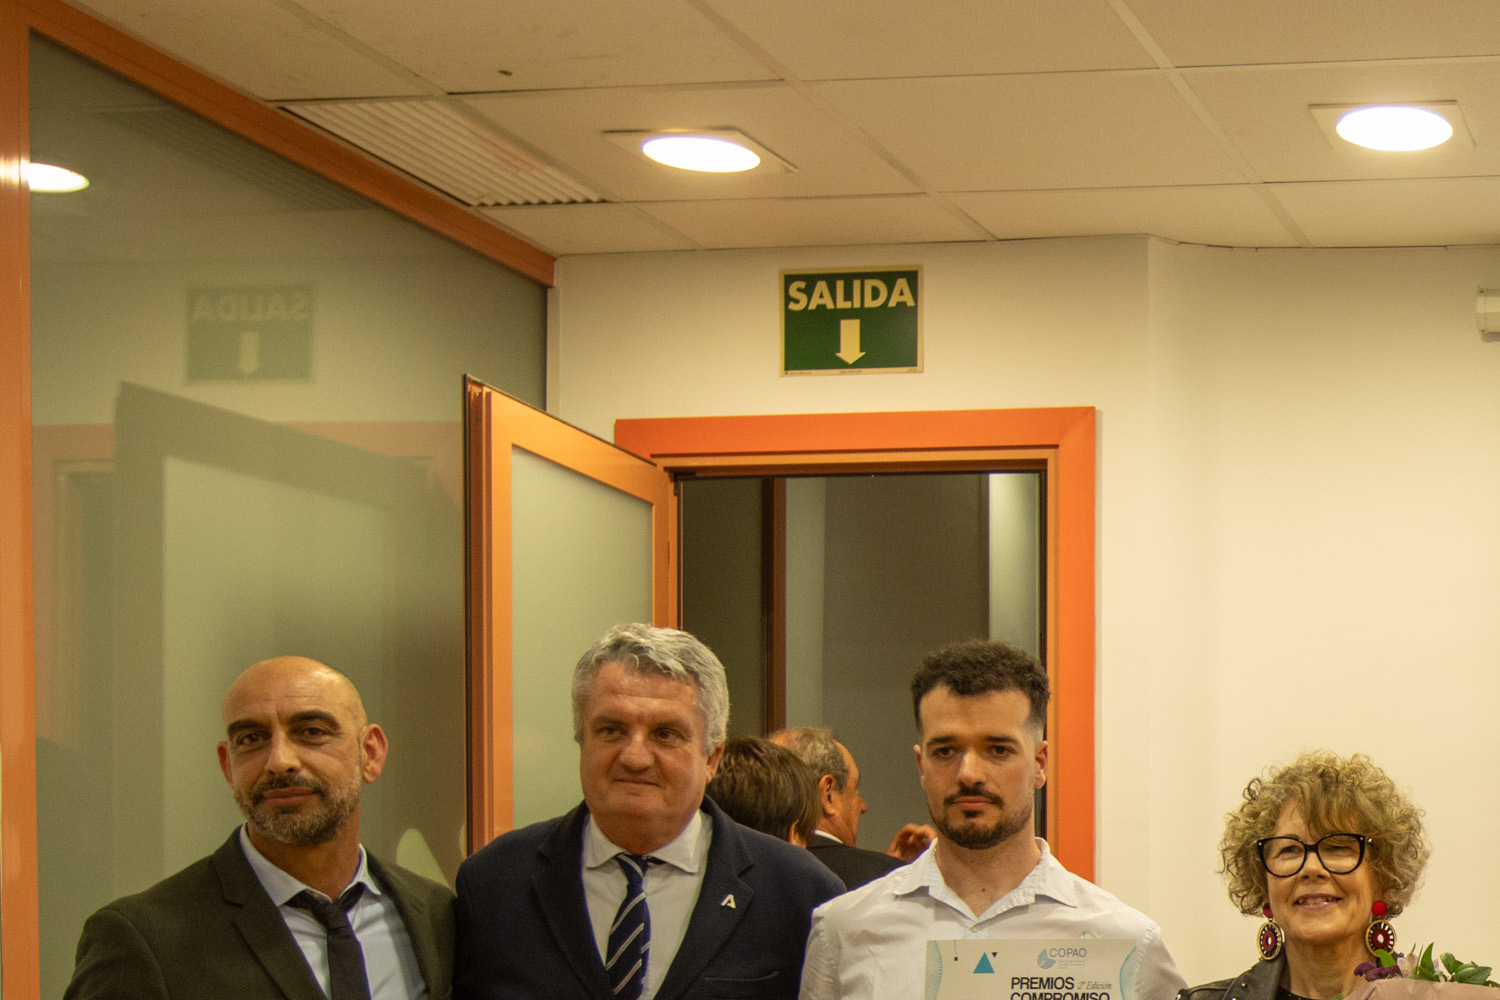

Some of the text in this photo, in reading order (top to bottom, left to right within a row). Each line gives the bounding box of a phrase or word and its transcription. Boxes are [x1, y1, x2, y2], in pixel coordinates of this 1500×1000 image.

[788, 278, 916, 311] SALIDA
[1049, 947, 1087, 958] COPAO
[1011, 977, 1075, 990] PREMIOS
[1086, 980, 1112, 990] Edición
